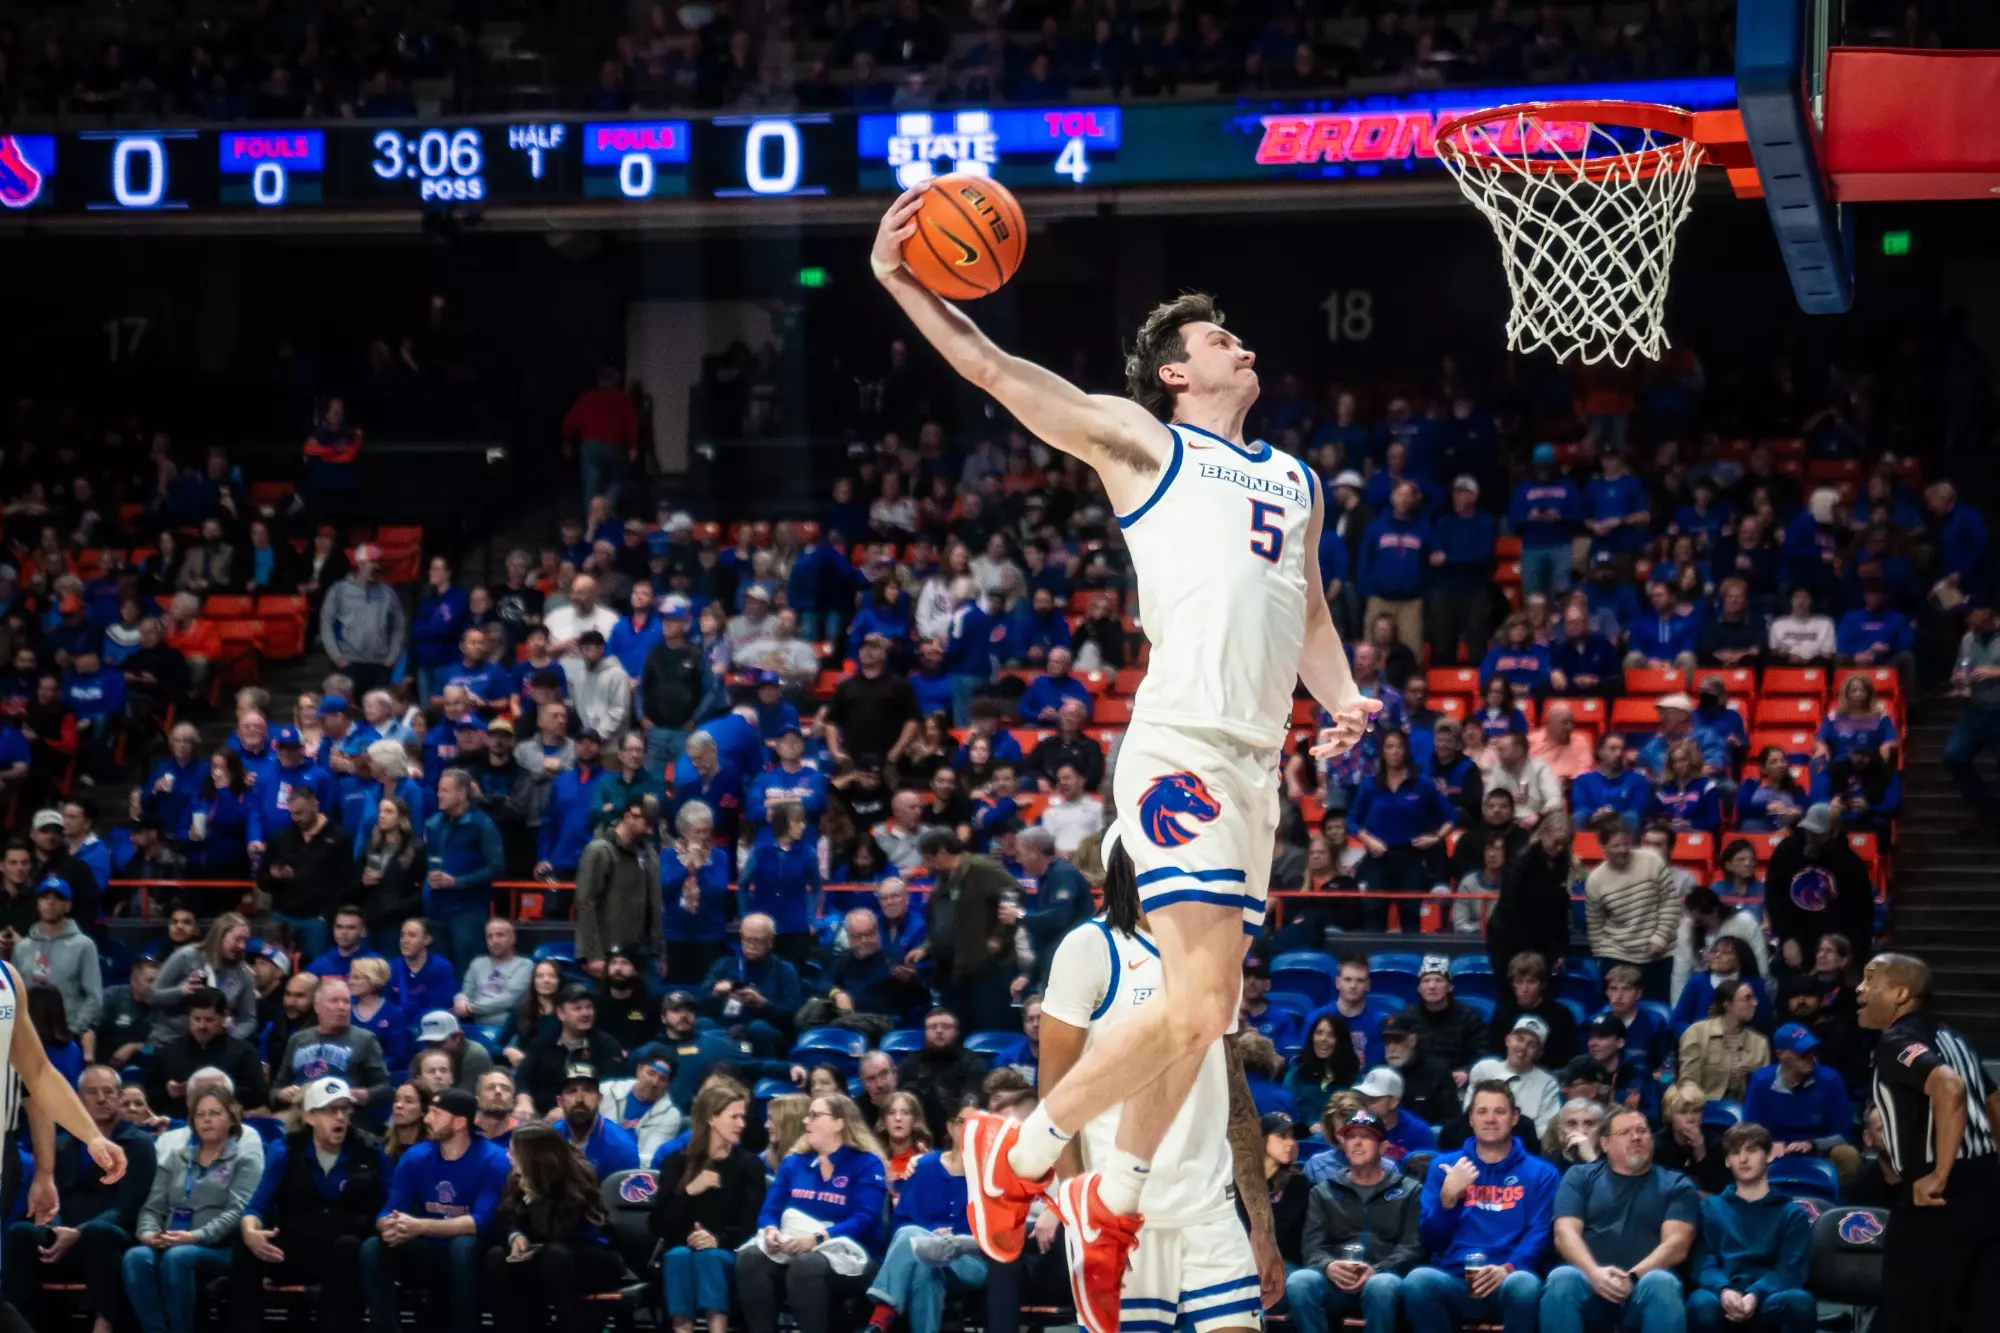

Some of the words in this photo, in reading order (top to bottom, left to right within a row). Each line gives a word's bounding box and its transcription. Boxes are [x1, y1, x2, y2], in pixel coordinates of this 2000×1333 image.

[508, 124, 565, 149] HALF
[597, 125, 675, 151] FOULS
[1044, 112, 1103, 137] TOL
[233, 136, 308, 159] FOULS
[372, 129, 481, 178] 3:06
[527, 147, 544, 179] 1
[745, 120, 800, 194] 0
[888, 132, 999, 166] STATE
[1054, 137, 1091, 183] 4
[113, 138, 164, 206] 0
[253, 162, 286, 205] 0
[421, 178, 484, 200] POSS
[620, 153, 653, 197] 0
[960, 186, 1010, 244] ELITE
[1319, 288, 1374, 342] 18
[102, 315, 149, 362] 17
[1198, 462, 1307, 509] BRONCOS
[1245, 496, 1286, 565] 5
[1464, 1184, 1525, 1204] RONCOS
